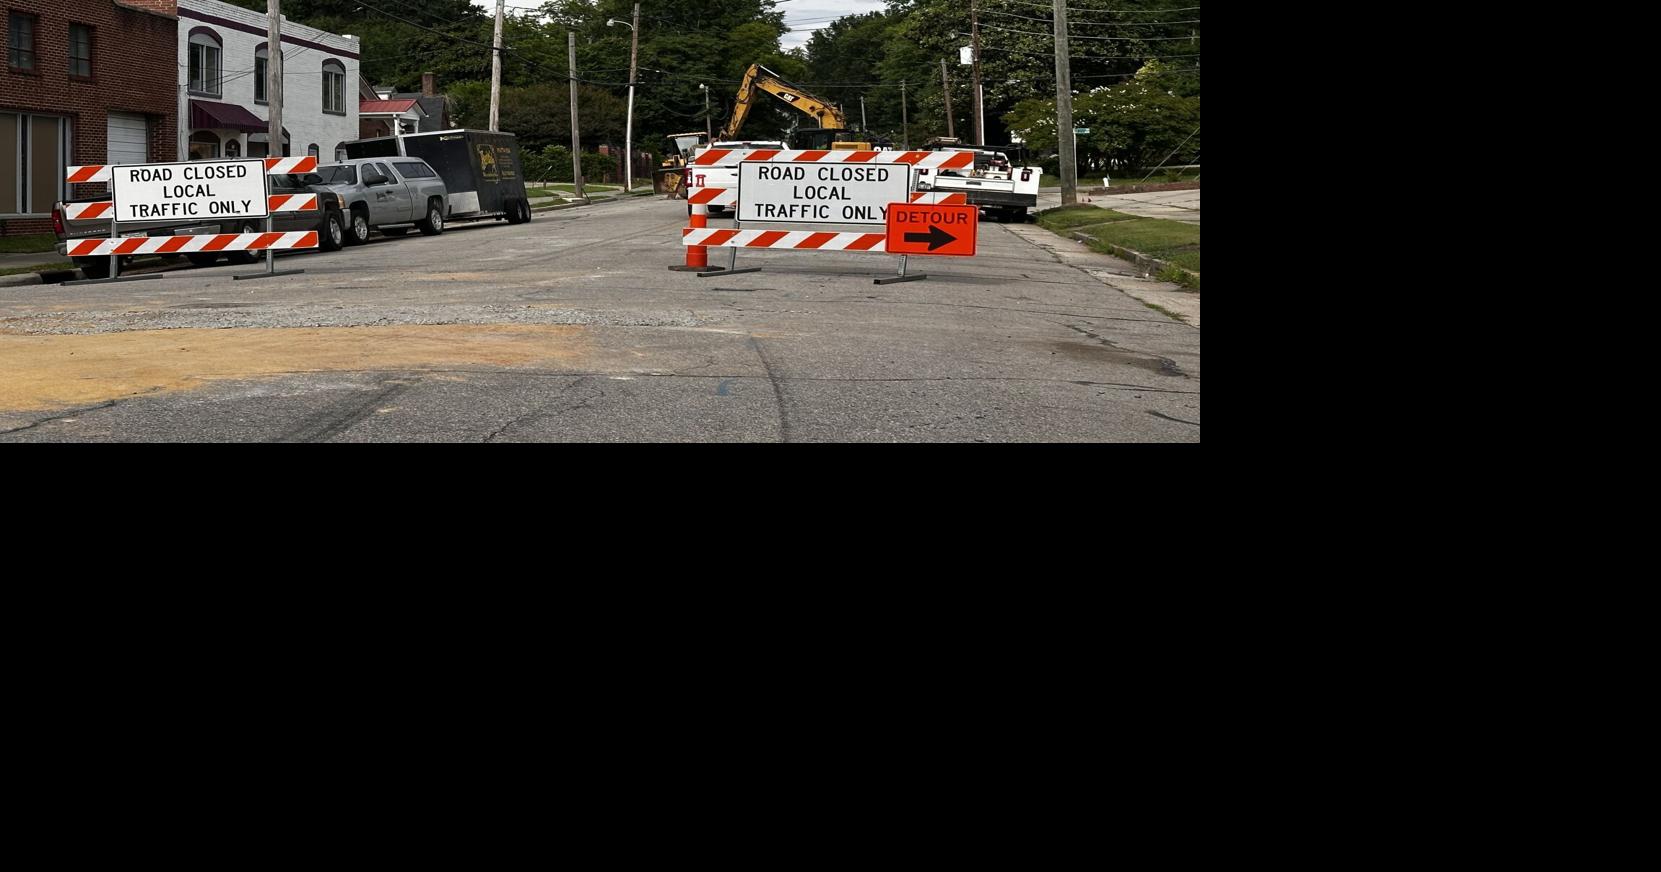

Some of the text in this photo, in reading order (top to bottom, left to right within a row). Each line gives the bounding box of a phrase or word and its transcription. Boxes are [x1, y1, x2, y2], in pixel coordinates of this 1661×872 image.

[783, 93, 795, 102] CAT
[130, 164, 247, 182] ROAD CLOSED
[758, 166, 889, 182] ROAD CLOSED
[163, 184, 216, 198] LOCAL
[793, 186, 851, 200] LOCAL
[130, 200, 251, 217] TRAFFIC ONLY
[755, 203, 888, 220] TRAFFIC ONLY
[896, 211, 968, 225] DETOUR
